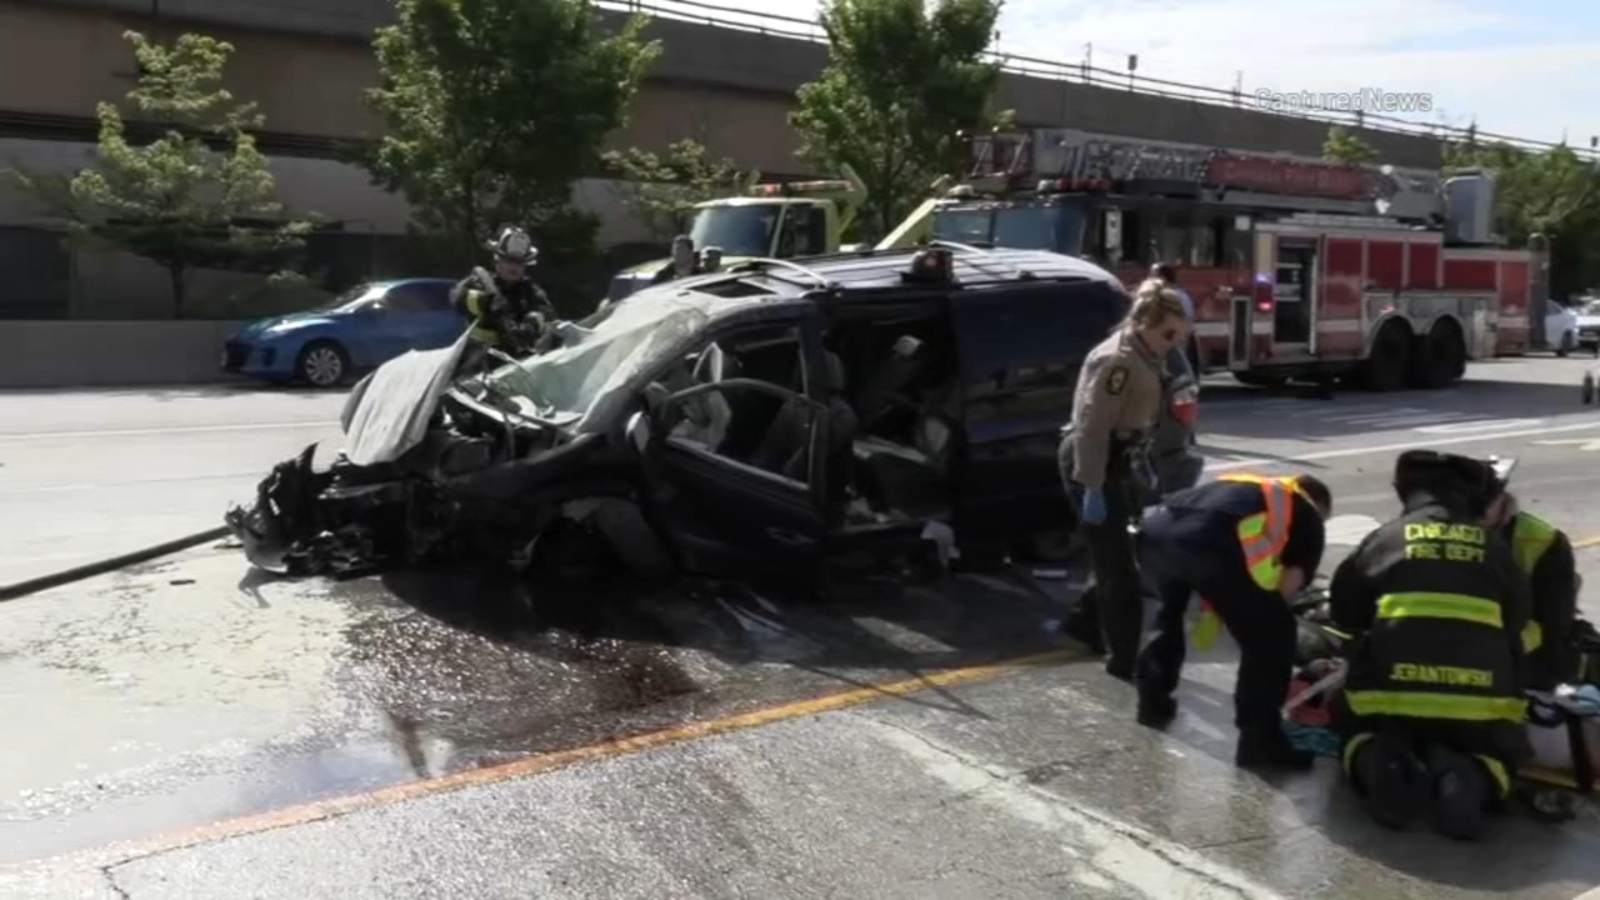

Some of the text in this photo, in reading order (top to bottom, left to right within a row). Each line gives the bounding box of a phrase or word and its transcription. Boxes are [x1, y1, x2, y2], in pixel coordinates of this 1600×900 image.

[1404, 523, 1485, 544] CHICAGO
[1405, 544, 1485, 562] FIRE DEPT
